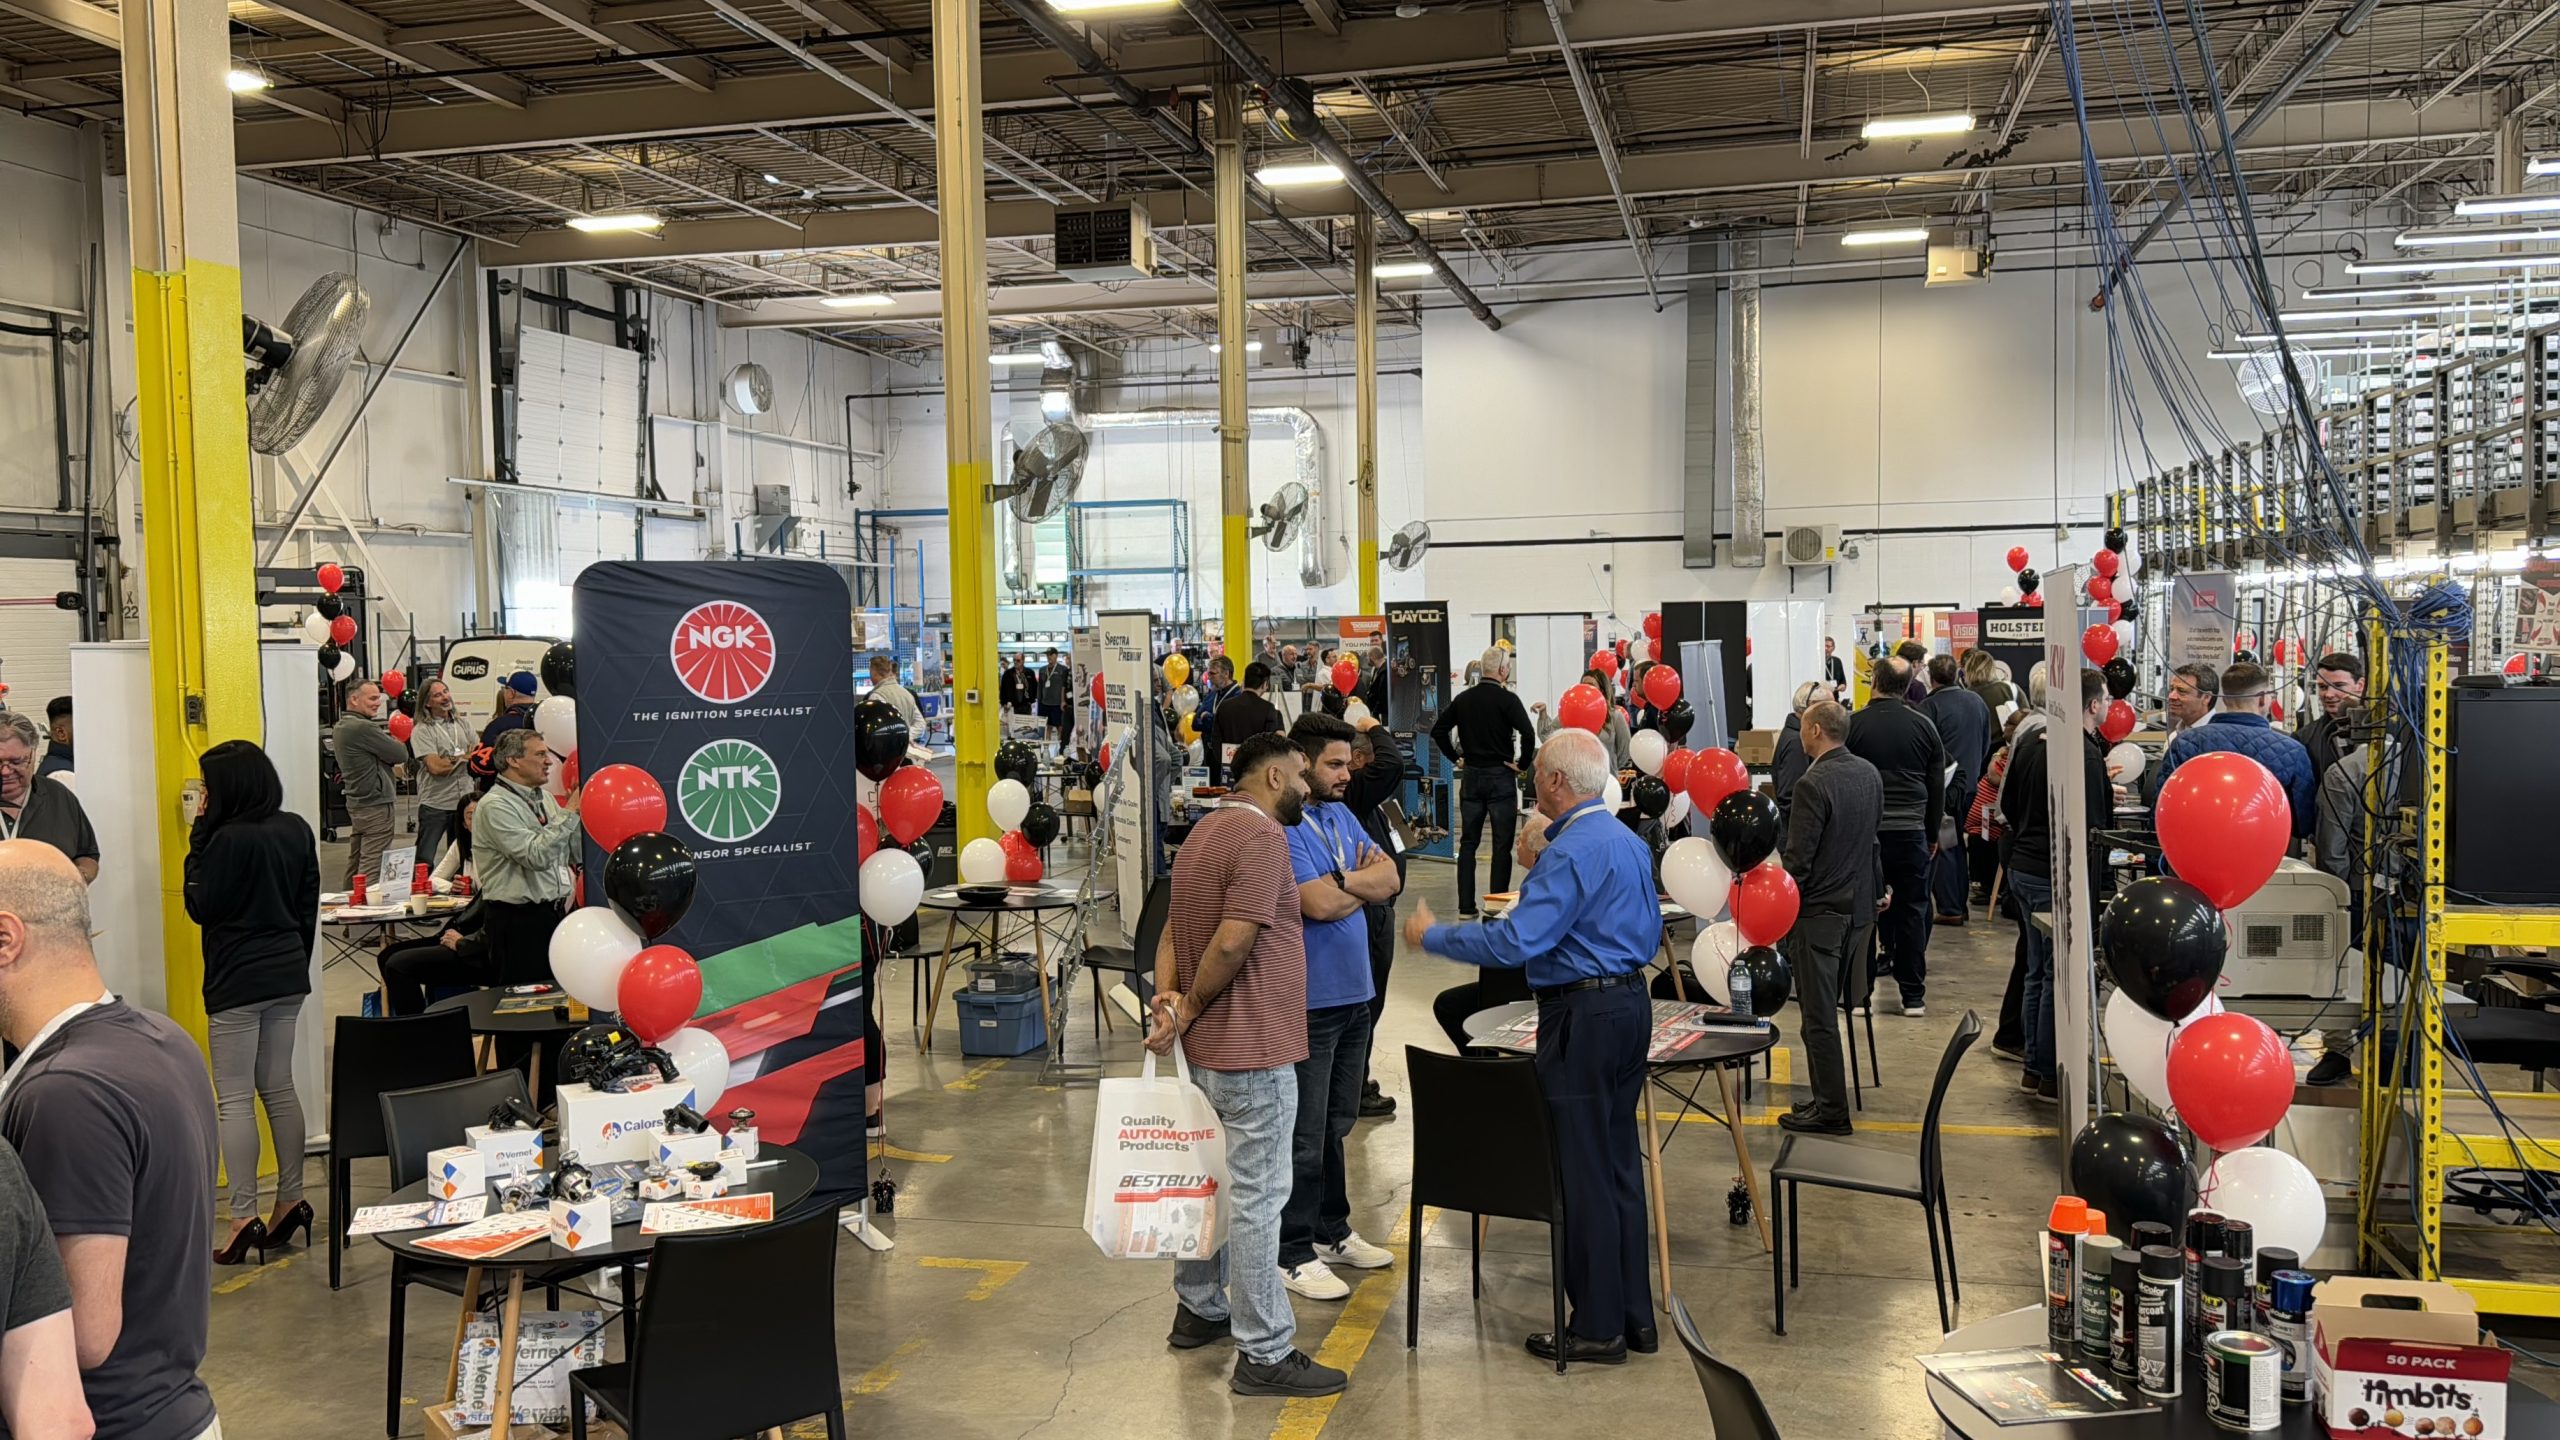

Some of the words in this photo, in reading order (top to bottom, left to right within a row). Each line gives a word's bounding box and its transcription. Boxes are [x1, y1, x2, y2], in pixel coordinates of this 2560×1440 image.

[124, 606, 139, 619] 22
[1391, 609, 1442, 624] DAYCO
[1990, 622, 2045, 633] HOLSTEI
[688, 624, 756, 649] NGK
[453, 664, 487, 675] GURUS
[1105, 683, 1126, 697] COOLING
[1106, 697, 1127, 711] SYSTEM
[633, 712, 660, 722] THE
[665, 709, 728, 721] IGNITION
[734, 706, 813, 718] SPECIALIST
[1107, 710, 1133, 725] PRODUCTS
[697, 764, 762, 791] NTK
[693, 849, 729, 860] NSOR
[734, 841, 812, 856] SPECIALIST
[623, 1119, 664, 1132] Calors
[1120, 1115, 1176, 1129] Quality
[1118, 1128, 1216, 1142] AUTOMOTIVE
[505, 1149, 533, 1160] Vernet
[1119, 1174, 1206, 1188] BESTBUY
[2386, 1354, 2405, 1366] 50
[2410, 1356, 2457, 1370] PACK
[471, 1363, 494, 1411] Verne
[2363, 1378, 2472, 1411] timbits
